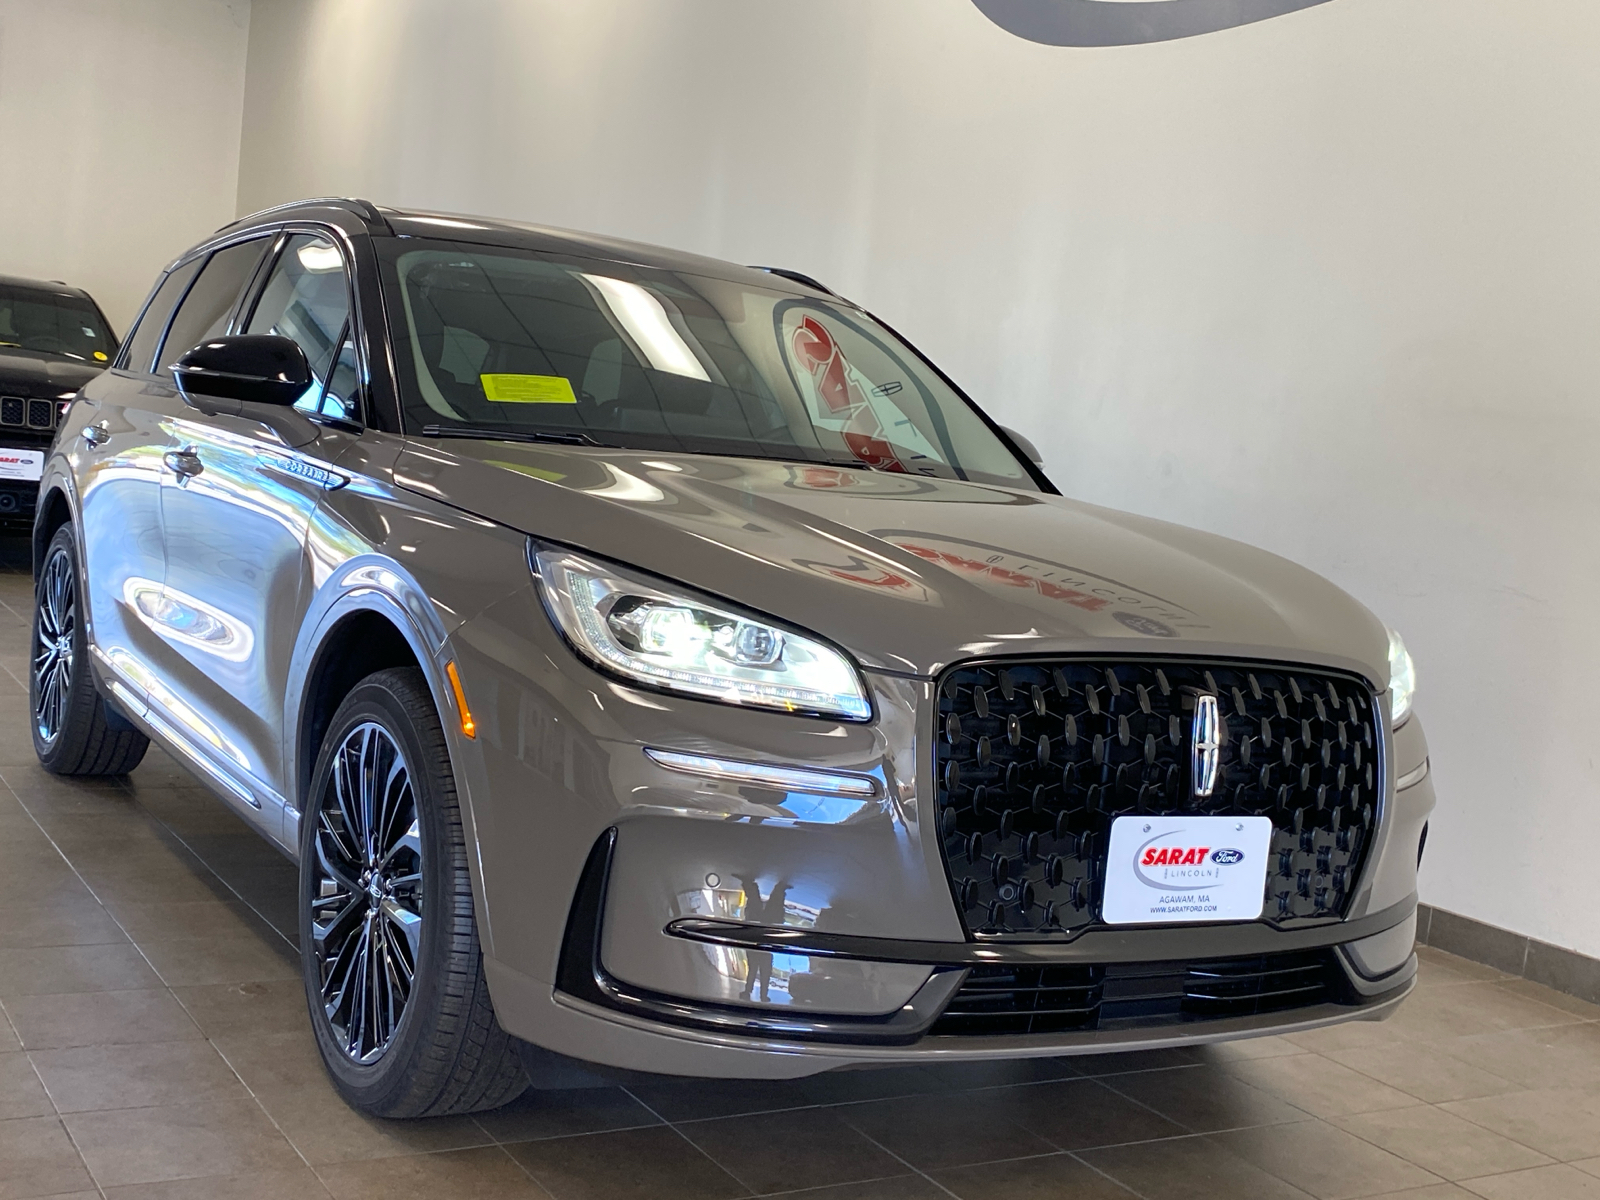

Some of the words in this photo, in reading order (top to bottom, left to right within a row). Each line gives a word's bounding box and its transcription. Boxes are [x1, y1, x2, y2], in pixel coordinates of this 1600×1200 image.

[285, 459, 324, 481] CORSAIR
[1140, 847, 1211, 866] SARAT
[1213, 849, 1241, 865] Ford
[1170, 869, 1213, 877] LINCOLN
[1158, 895, 1195, 904] AGAWAM,
[1198, 895, 1210, 903] MA
[1150, 905, 1217, 913] WWW.SARATFORD.COM
